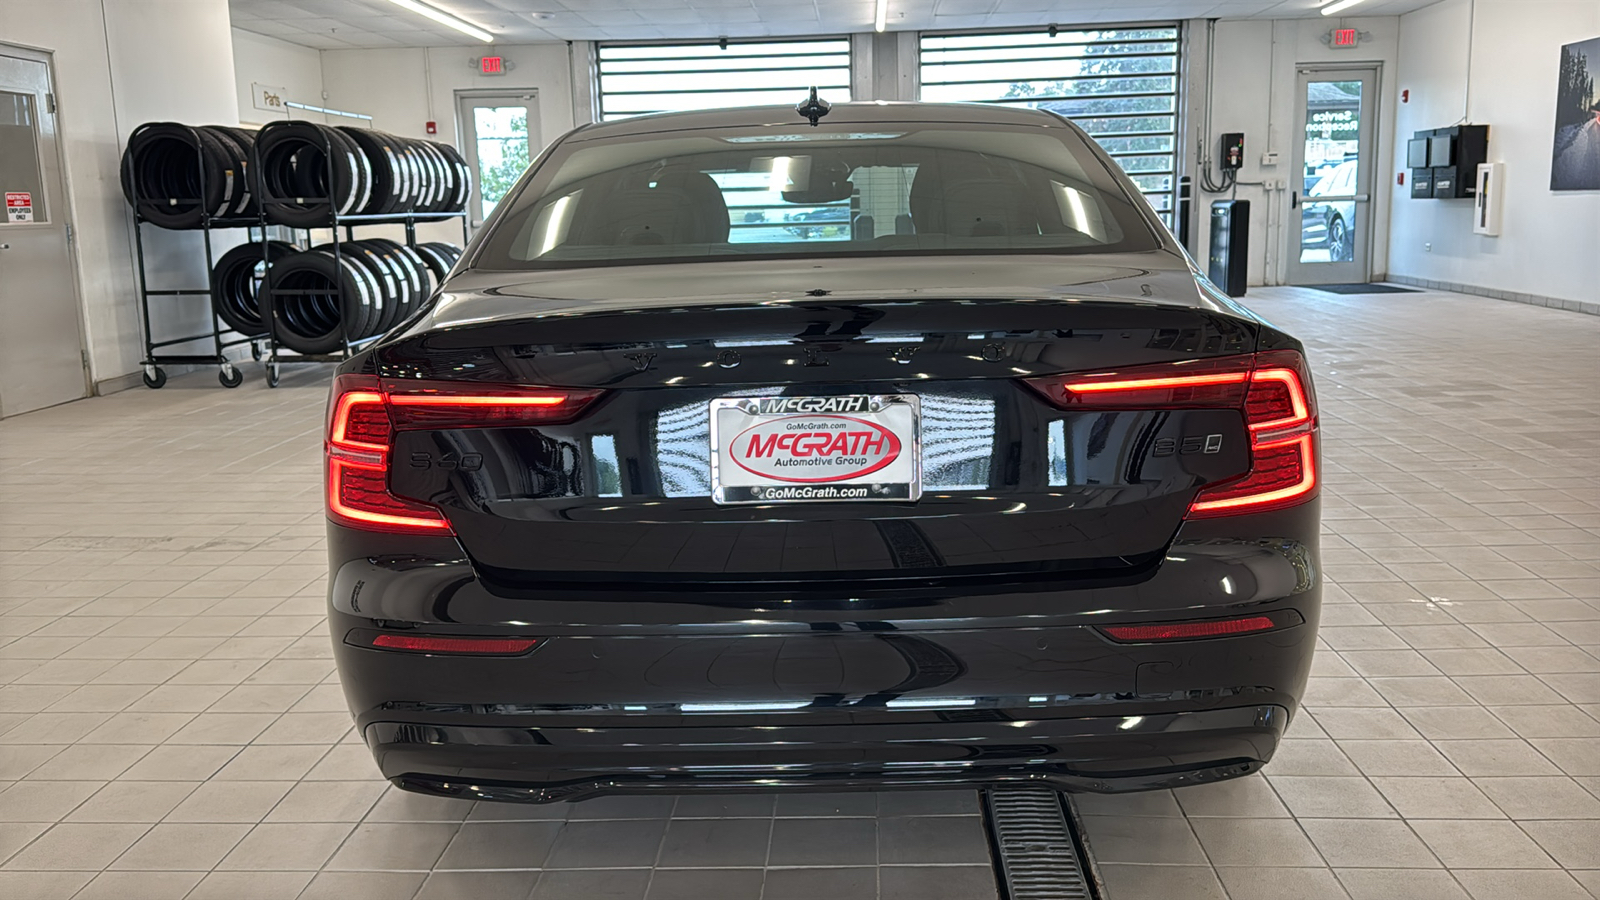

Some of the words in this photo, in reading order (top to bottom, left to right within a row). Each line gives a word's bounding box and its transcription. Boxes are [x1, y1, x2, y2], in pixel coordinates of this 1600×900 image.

[1336, 29, 1355, 45] EXIT
[482, 57, 501, 72] EXIT
[263, 90, 281, 107] Parts
[786, 422, 847, 431] GoMcGrath.com
[774, 457, 833, 468] Automotive
[834, 456, 868, 467] Group
[765, 486, 868, 500] GoMcGrath.com
